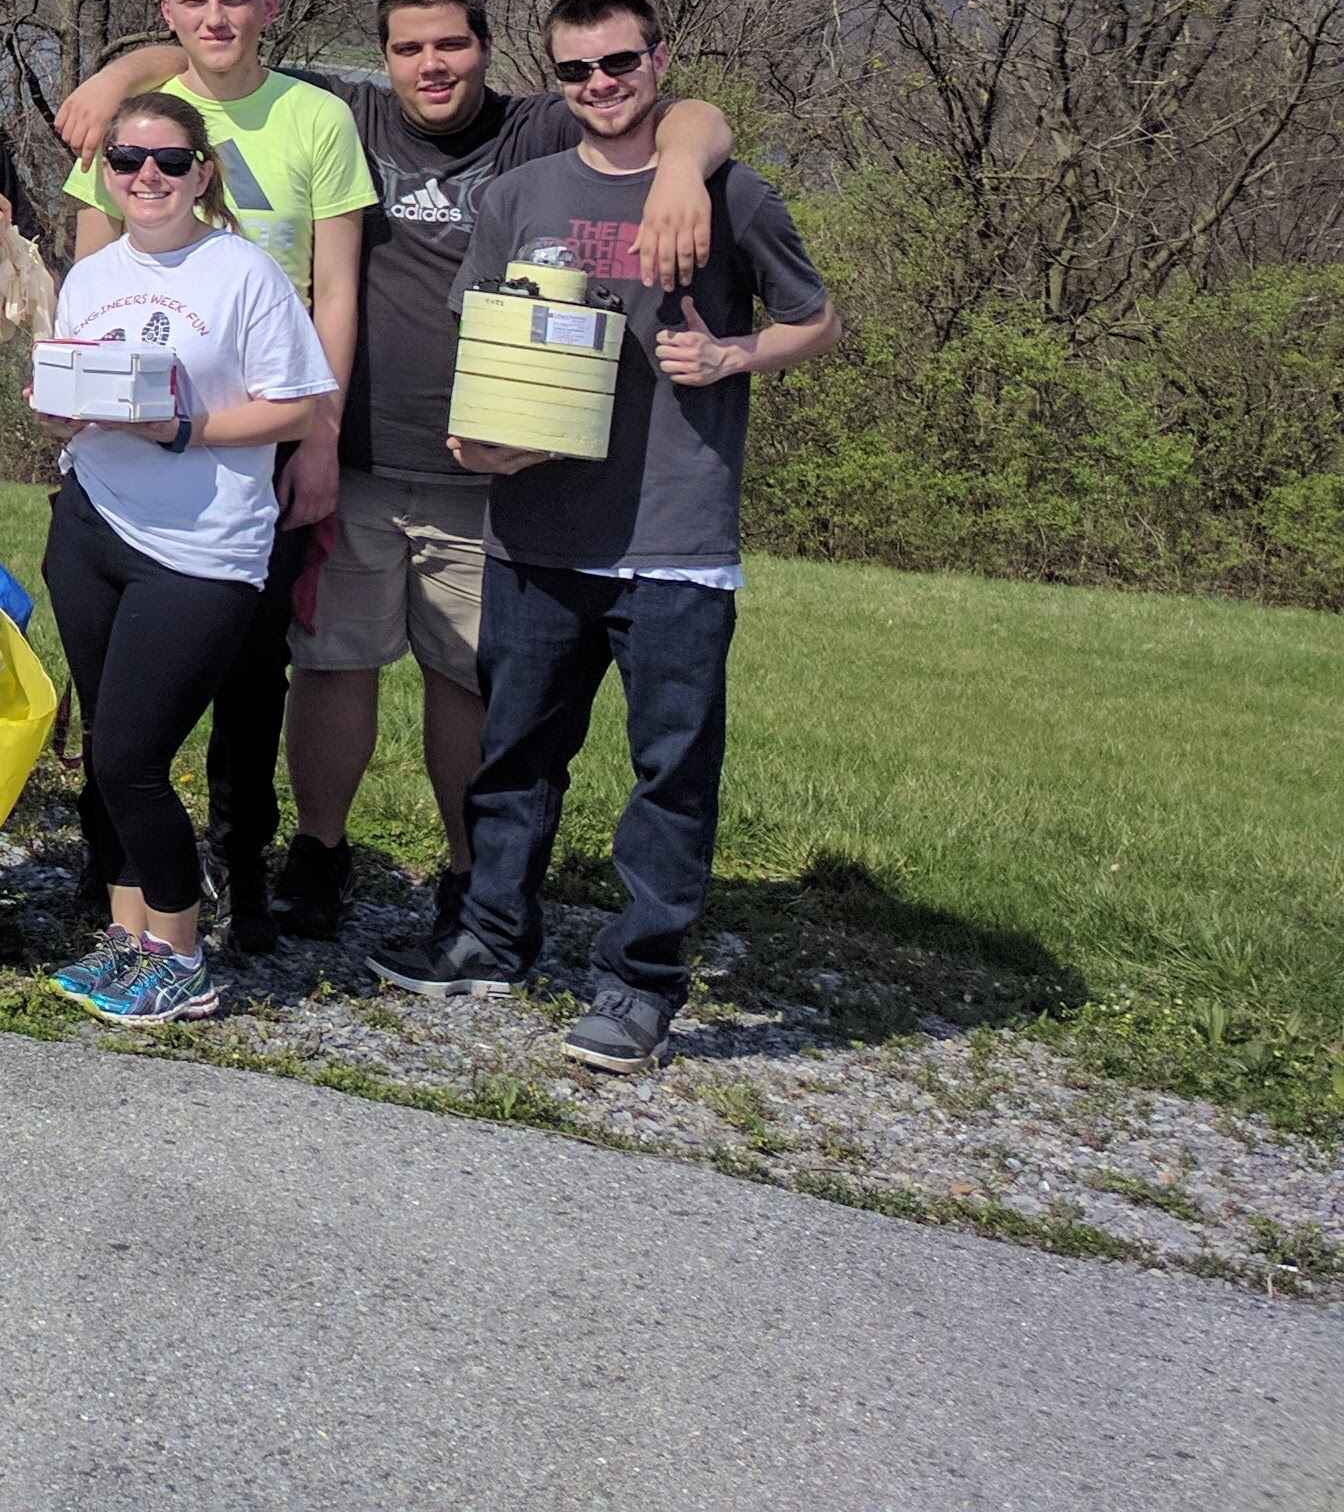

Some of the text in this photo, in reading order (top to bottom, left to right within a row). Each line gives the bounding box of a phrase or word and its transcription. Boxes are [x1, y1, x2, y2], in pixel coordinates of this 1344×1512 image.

[391, 203, 462, 222] adidas
[569, 218, 618, 238] THE
[150, 294, 188, 313] WEEK
[185, 312, 211, 337] FUN
